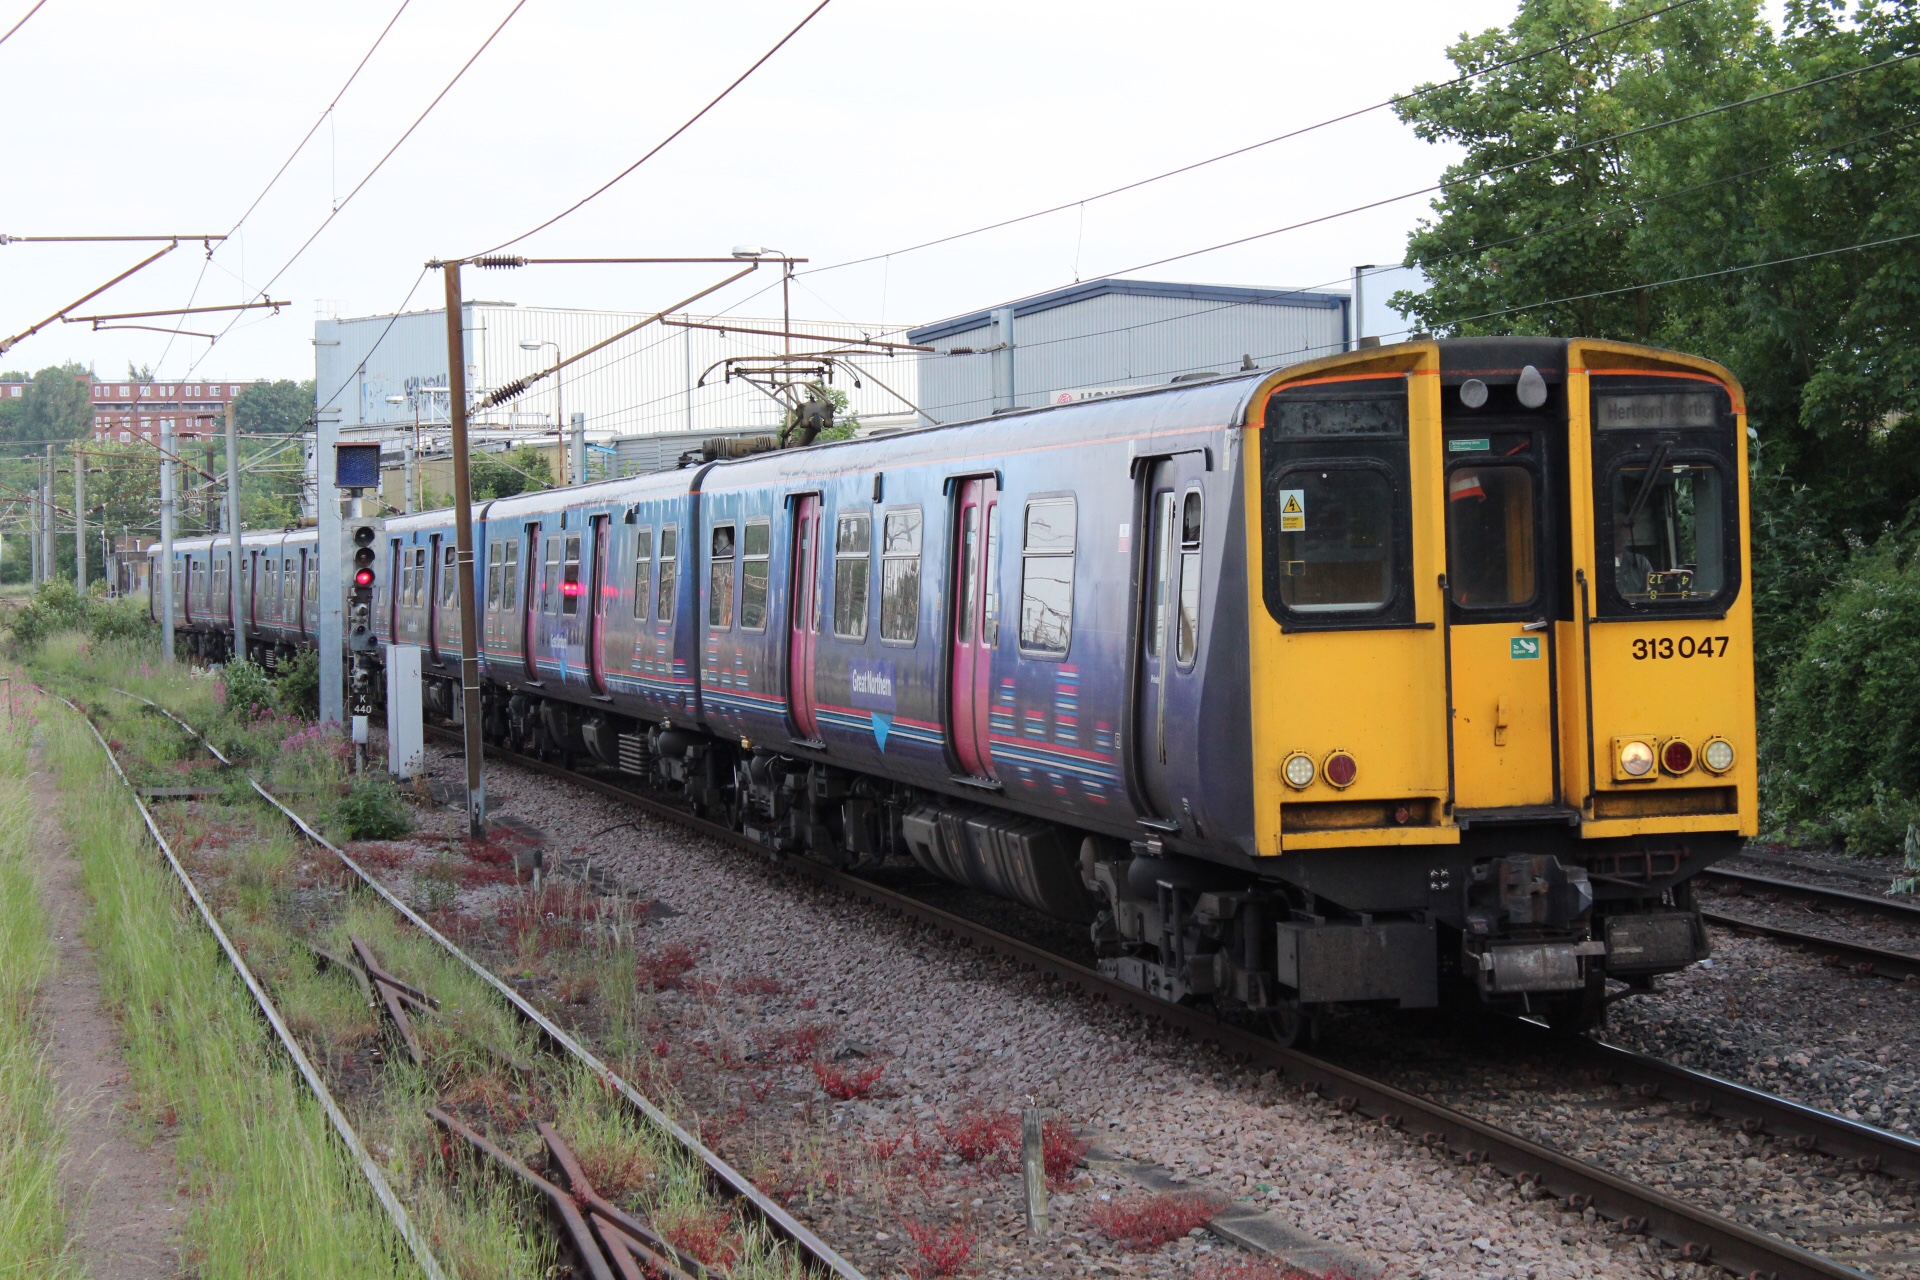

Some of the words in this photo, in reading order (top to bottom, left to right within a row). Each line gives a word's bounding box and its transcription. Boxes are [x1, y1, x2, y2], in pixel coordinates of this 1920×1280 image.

[852, 669, 867, 693] Great
[867, 670, 892, 697] Northern
[359, 694, 366, 703] K
[354, 704, 372, 714] 440
